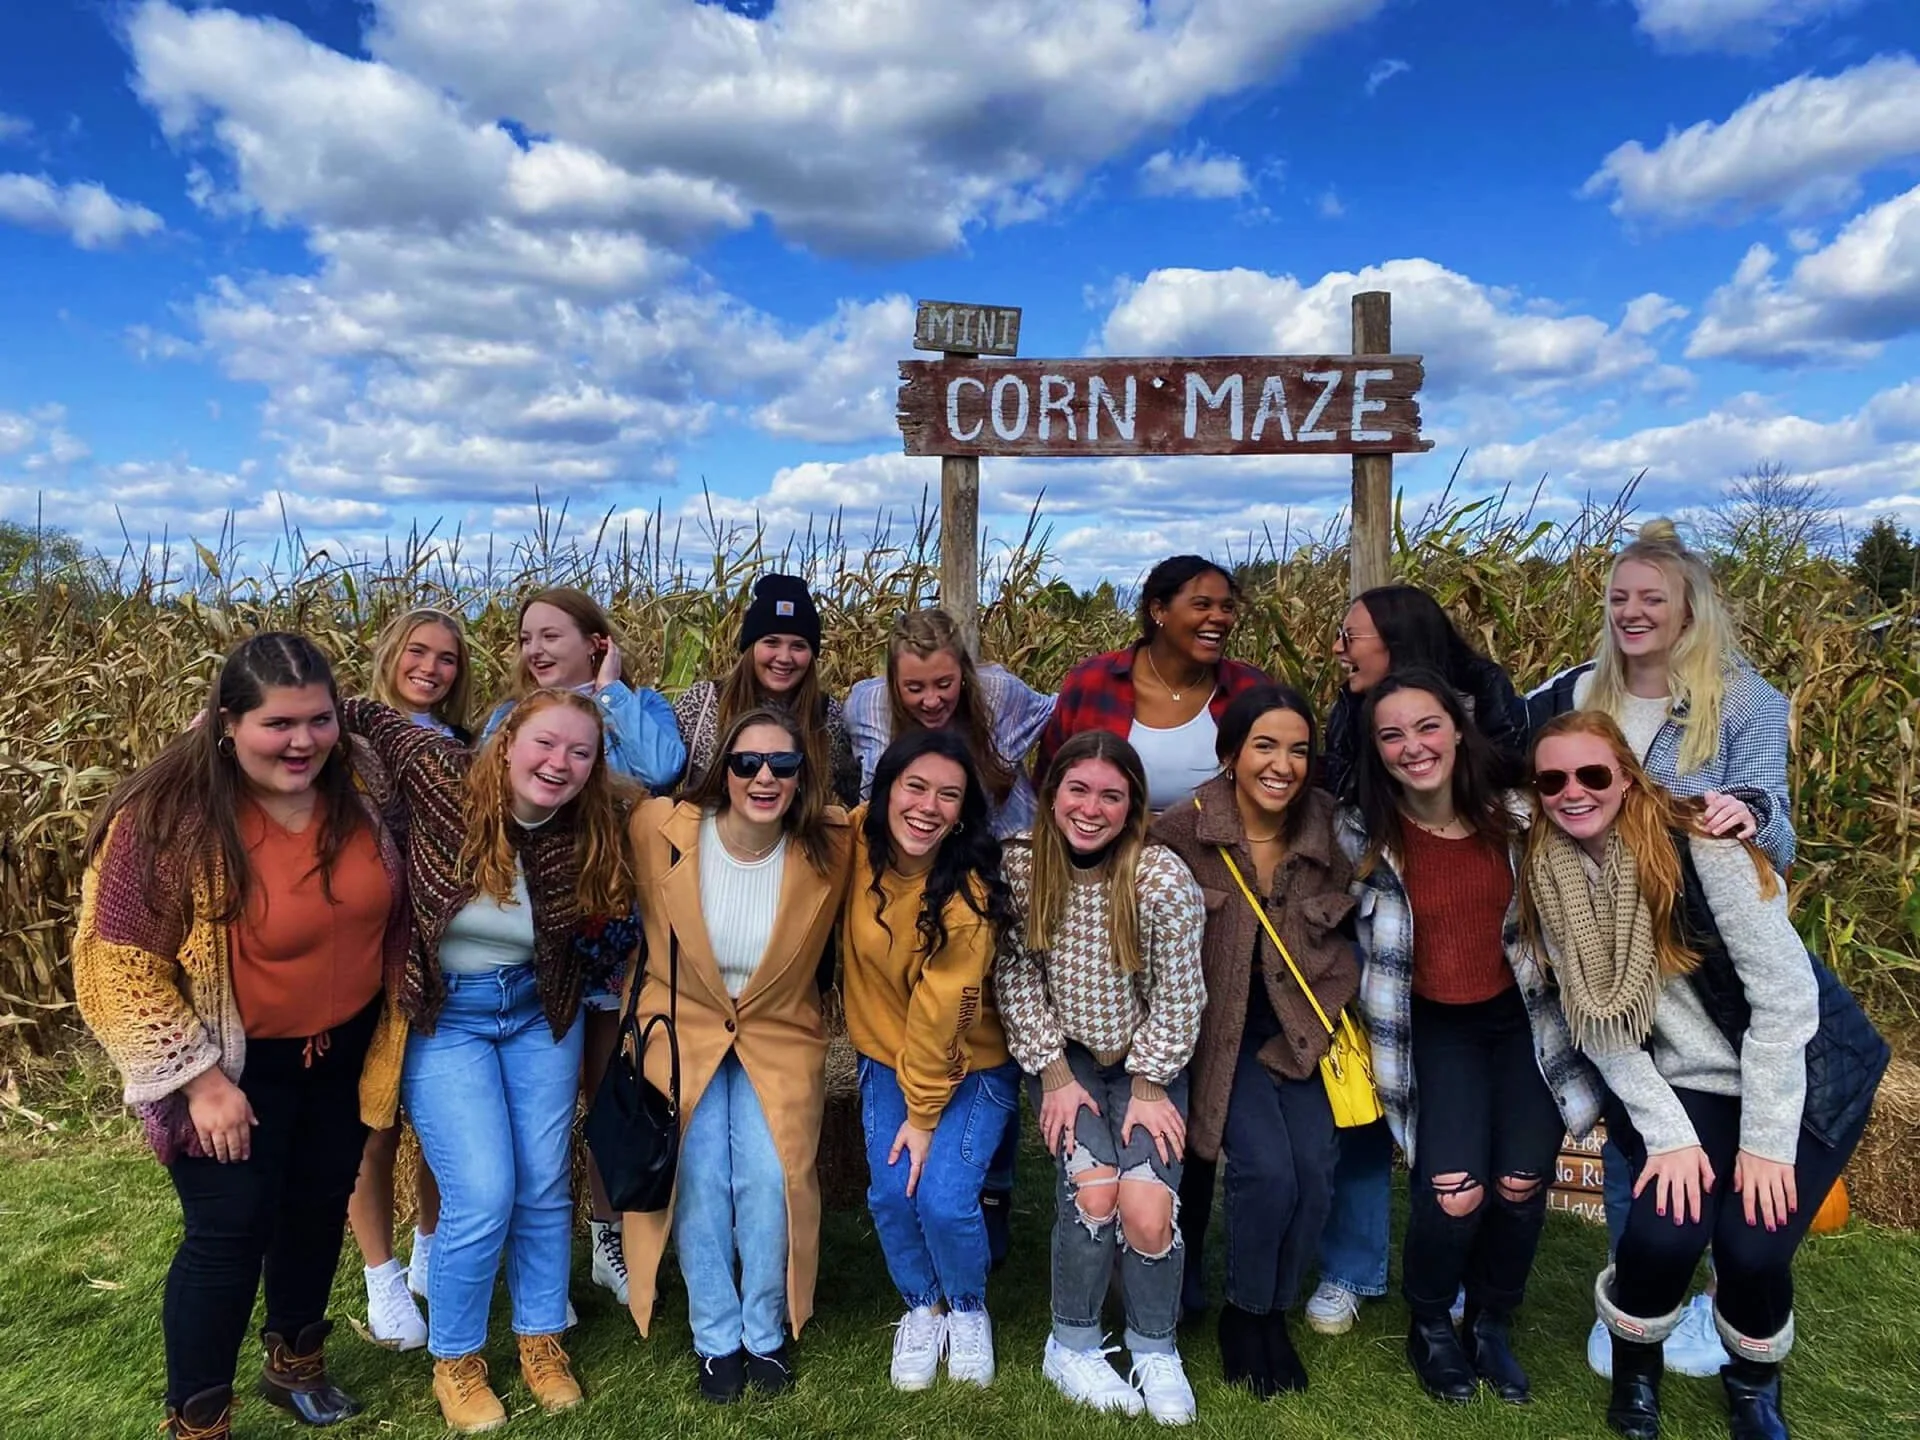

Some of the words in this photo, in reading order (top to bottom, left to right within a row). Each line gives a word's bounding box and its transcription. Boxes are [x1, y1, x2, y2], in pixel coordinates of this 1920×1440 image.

[927, 307, 1017, 351] MINI
[946, 374, 1137, 442] CORN
[1184, 369, 1394, 442] MAZE
